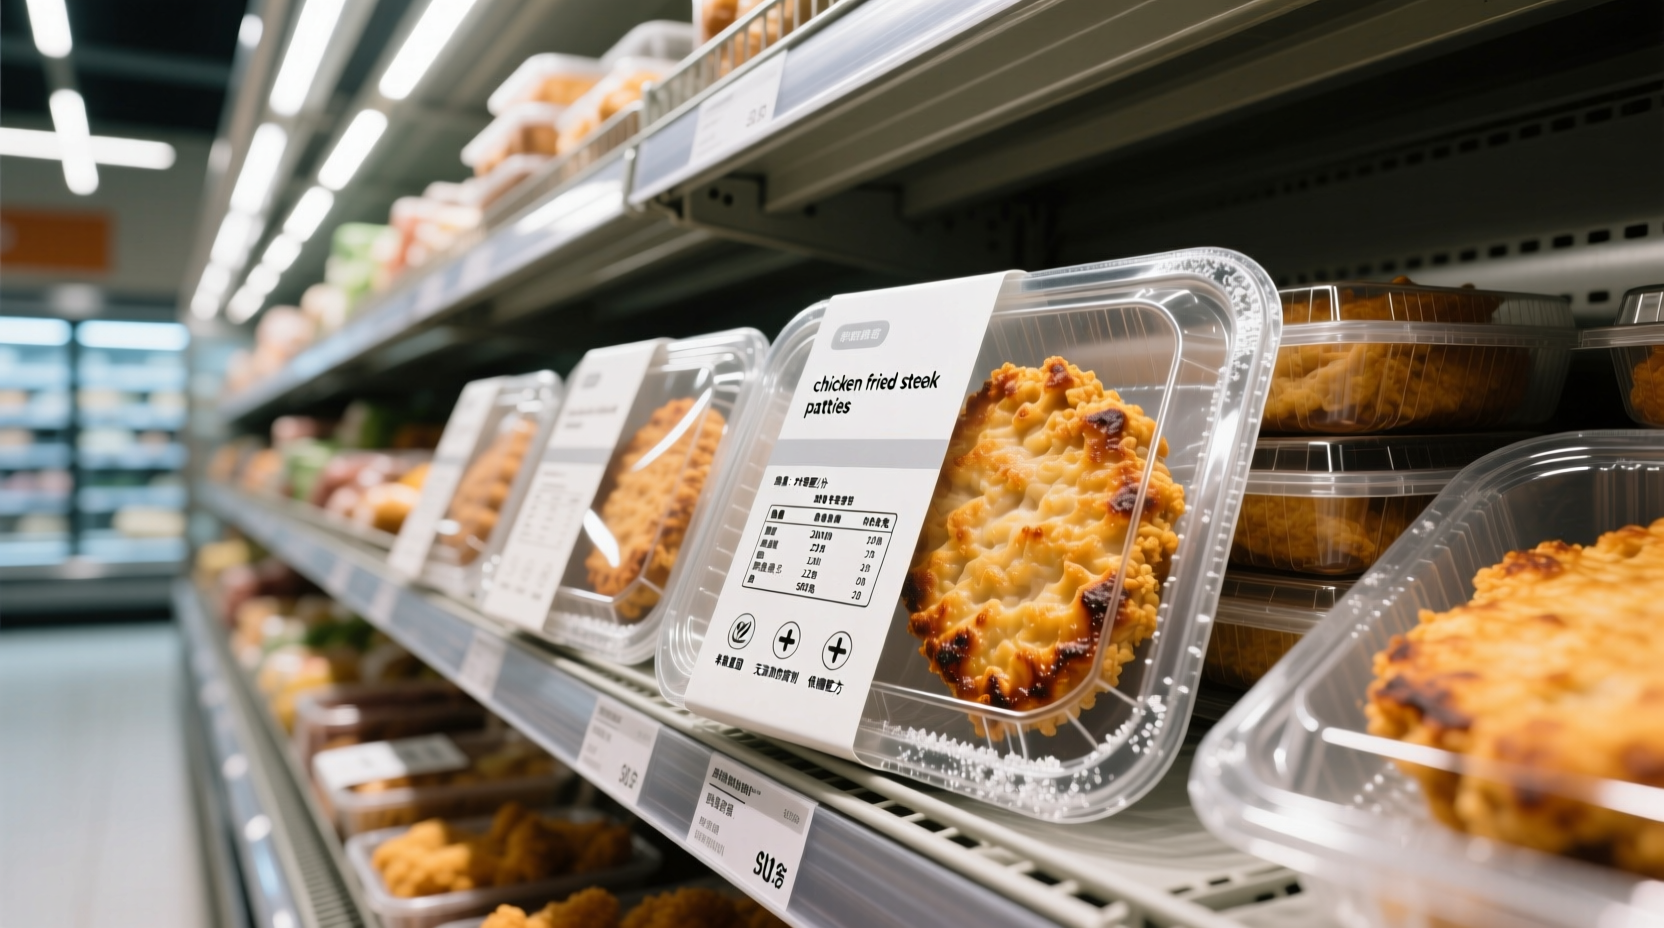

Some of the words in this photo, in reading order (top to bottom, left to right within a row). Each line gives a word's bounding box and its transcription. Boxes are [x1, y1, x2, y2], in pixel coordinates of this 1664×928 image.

[813, 374, 863, 392] chicken
[866, 371, 899, 391] fried
[900, 370, 941, 390] steak
[803, 397, 852, 419] patties
